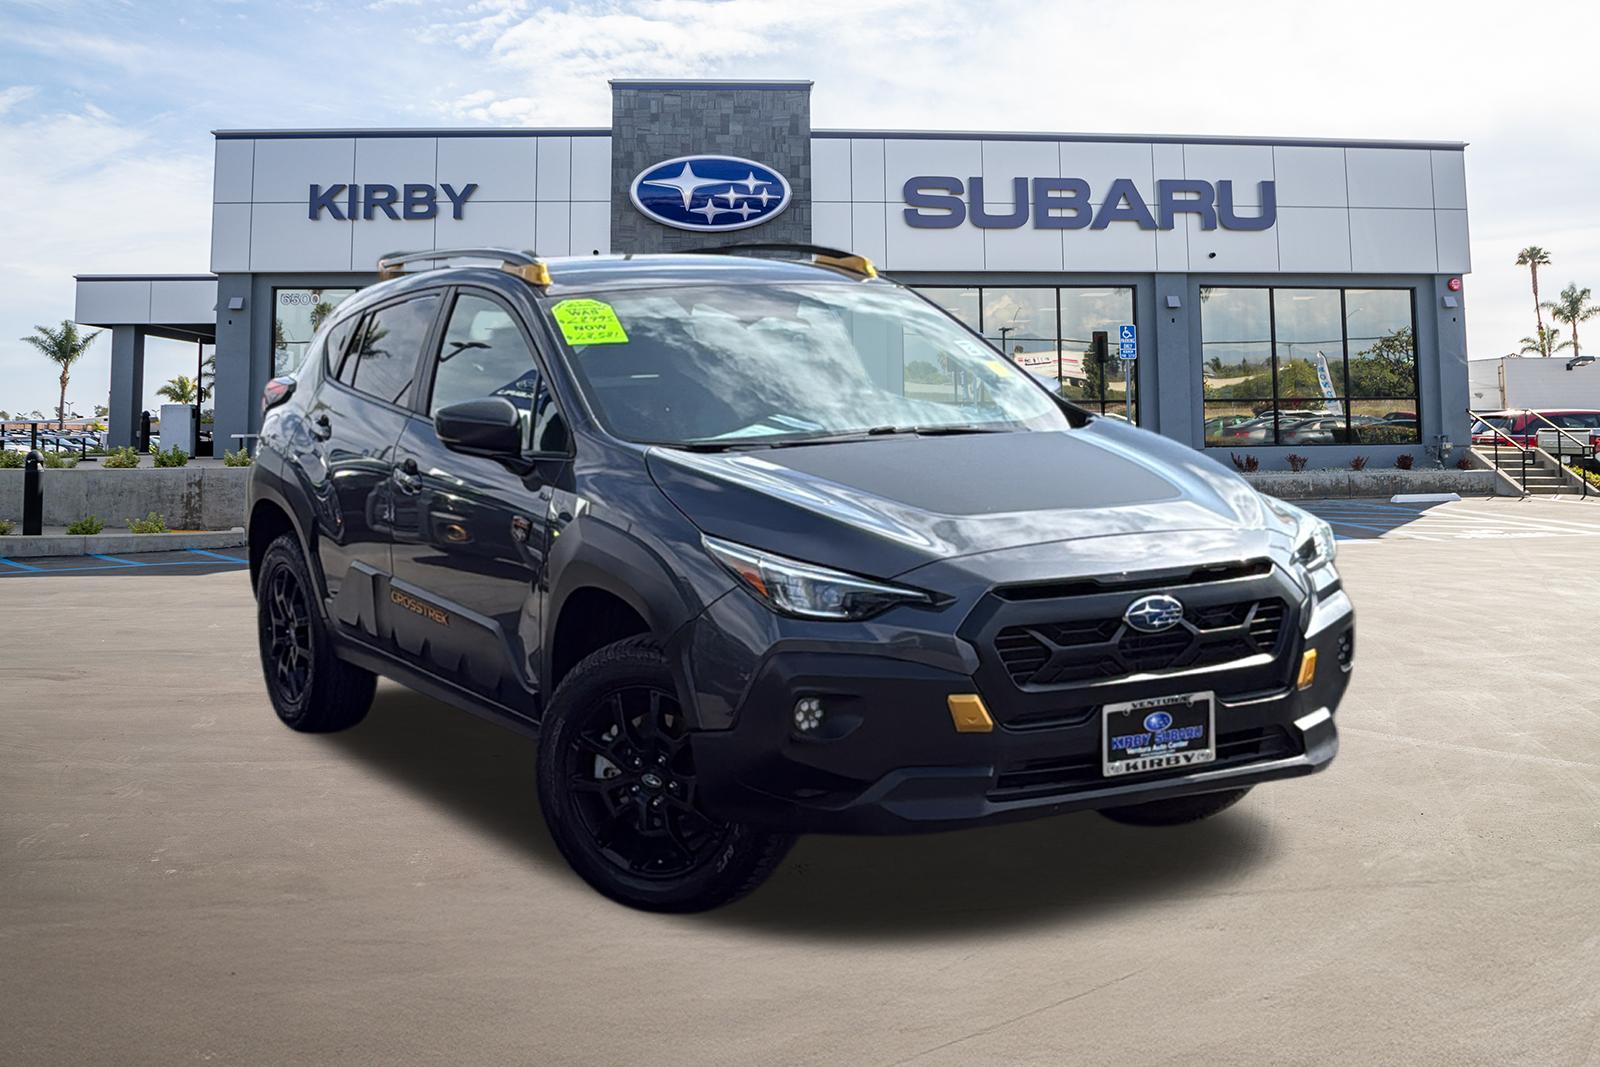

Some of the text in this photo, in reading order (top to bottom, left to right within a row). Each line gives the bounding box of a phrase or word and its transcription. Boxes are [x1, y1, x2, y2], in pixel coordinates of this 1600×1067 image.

[308, 183, 479, 220] KIRBY
[902, 176, 1277, 231] SUBARU
[391, 590, 449, 625] CROSSTREK
[1112, 725, 1203, 750] KIRBY SUBARU
[1125, 752, 1196, 771] KIRBY
